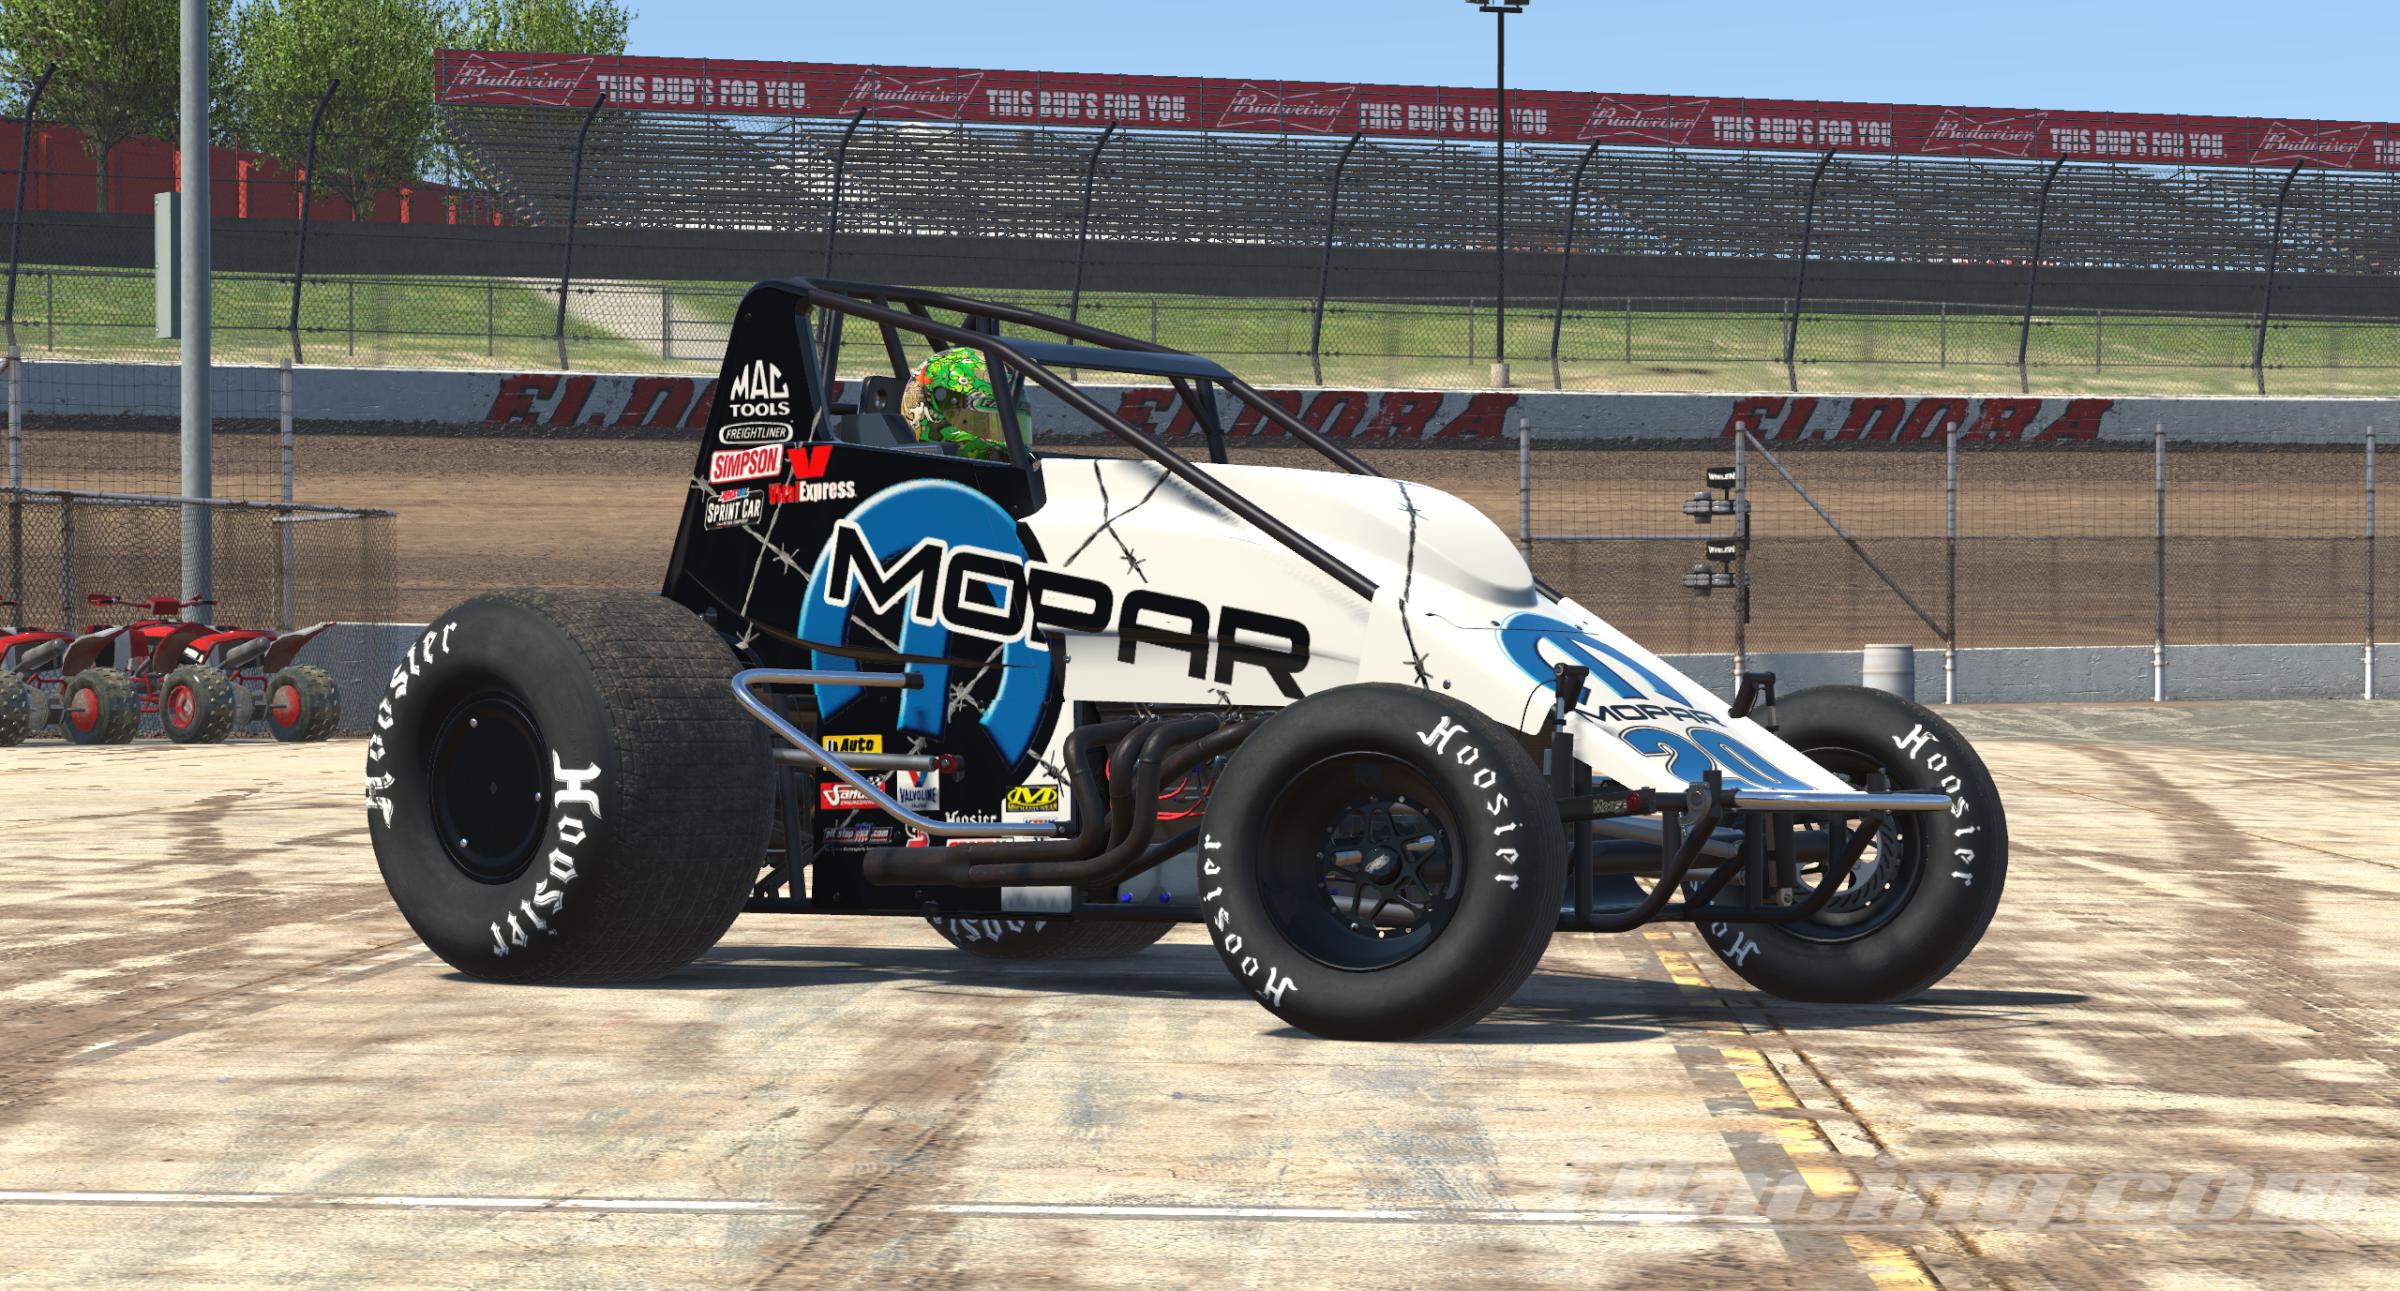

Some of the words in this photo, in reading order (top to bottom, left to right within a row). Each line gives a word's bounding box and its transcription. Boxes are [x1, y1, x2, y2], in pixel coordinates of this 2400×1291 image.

[458, 65, 577, 89] Budweiser
[596, 75, 645, 103] THIS
[652, 76, 712, 106] BUD'S
[720, 79, 758, 107] FOR
[853, 78, 969, 103] Budweiser
[986, 89, 1032, 117] THIS
[1040, 90, 1098, 119] BUD'S
[1104, 93, 1140, 121] FOR
[1230, 94, 1342, 117] Budweiser
[1359, 103, 1402, 130] THIS
[1408, 104, 1464, 132] BUD'S
[1590, 109, 1696, 129] Budweiser
[1712, 115, 1754, 143] THIS
[1760, 116, 1814, 144] BUD'S
[1819, 119, 1853, 146] FOR
[1940, 119, 2034, 142] Budweiser
[2050, 127, 2090, 155] THIS
[2095, 128, 2147, 157] BUD'S
[2152, 131, 2184, 158] FOR
[2263, 131, 2359, 153] Budweiser
[730, 360, 789, 400] MAC
[729, 401, 790, 417] TOOLS
[1722, 396, 2115, 443] ELDORA
[725, 424, 787, 440] FREIGHTLINER
[707, 501, 741, 524] SPRINT
[742, 498, 762, 519] CAR
[824, 519, 1310, 699] MOPAR
[1575, 704, 1727, 728] MOPAR
[840, 738, 874, 752] Auto
[1619, 726, 1820, 790] 20
[899, 787, 937, 803] VALVOLINE
[1417, 715, 1523, 890] Hoosier
[1892, 723, 1981, 887] Hoosier
[491, 749, 602, 957] Hoosier
[1203, 833, 1298, 1007] Hoosier
